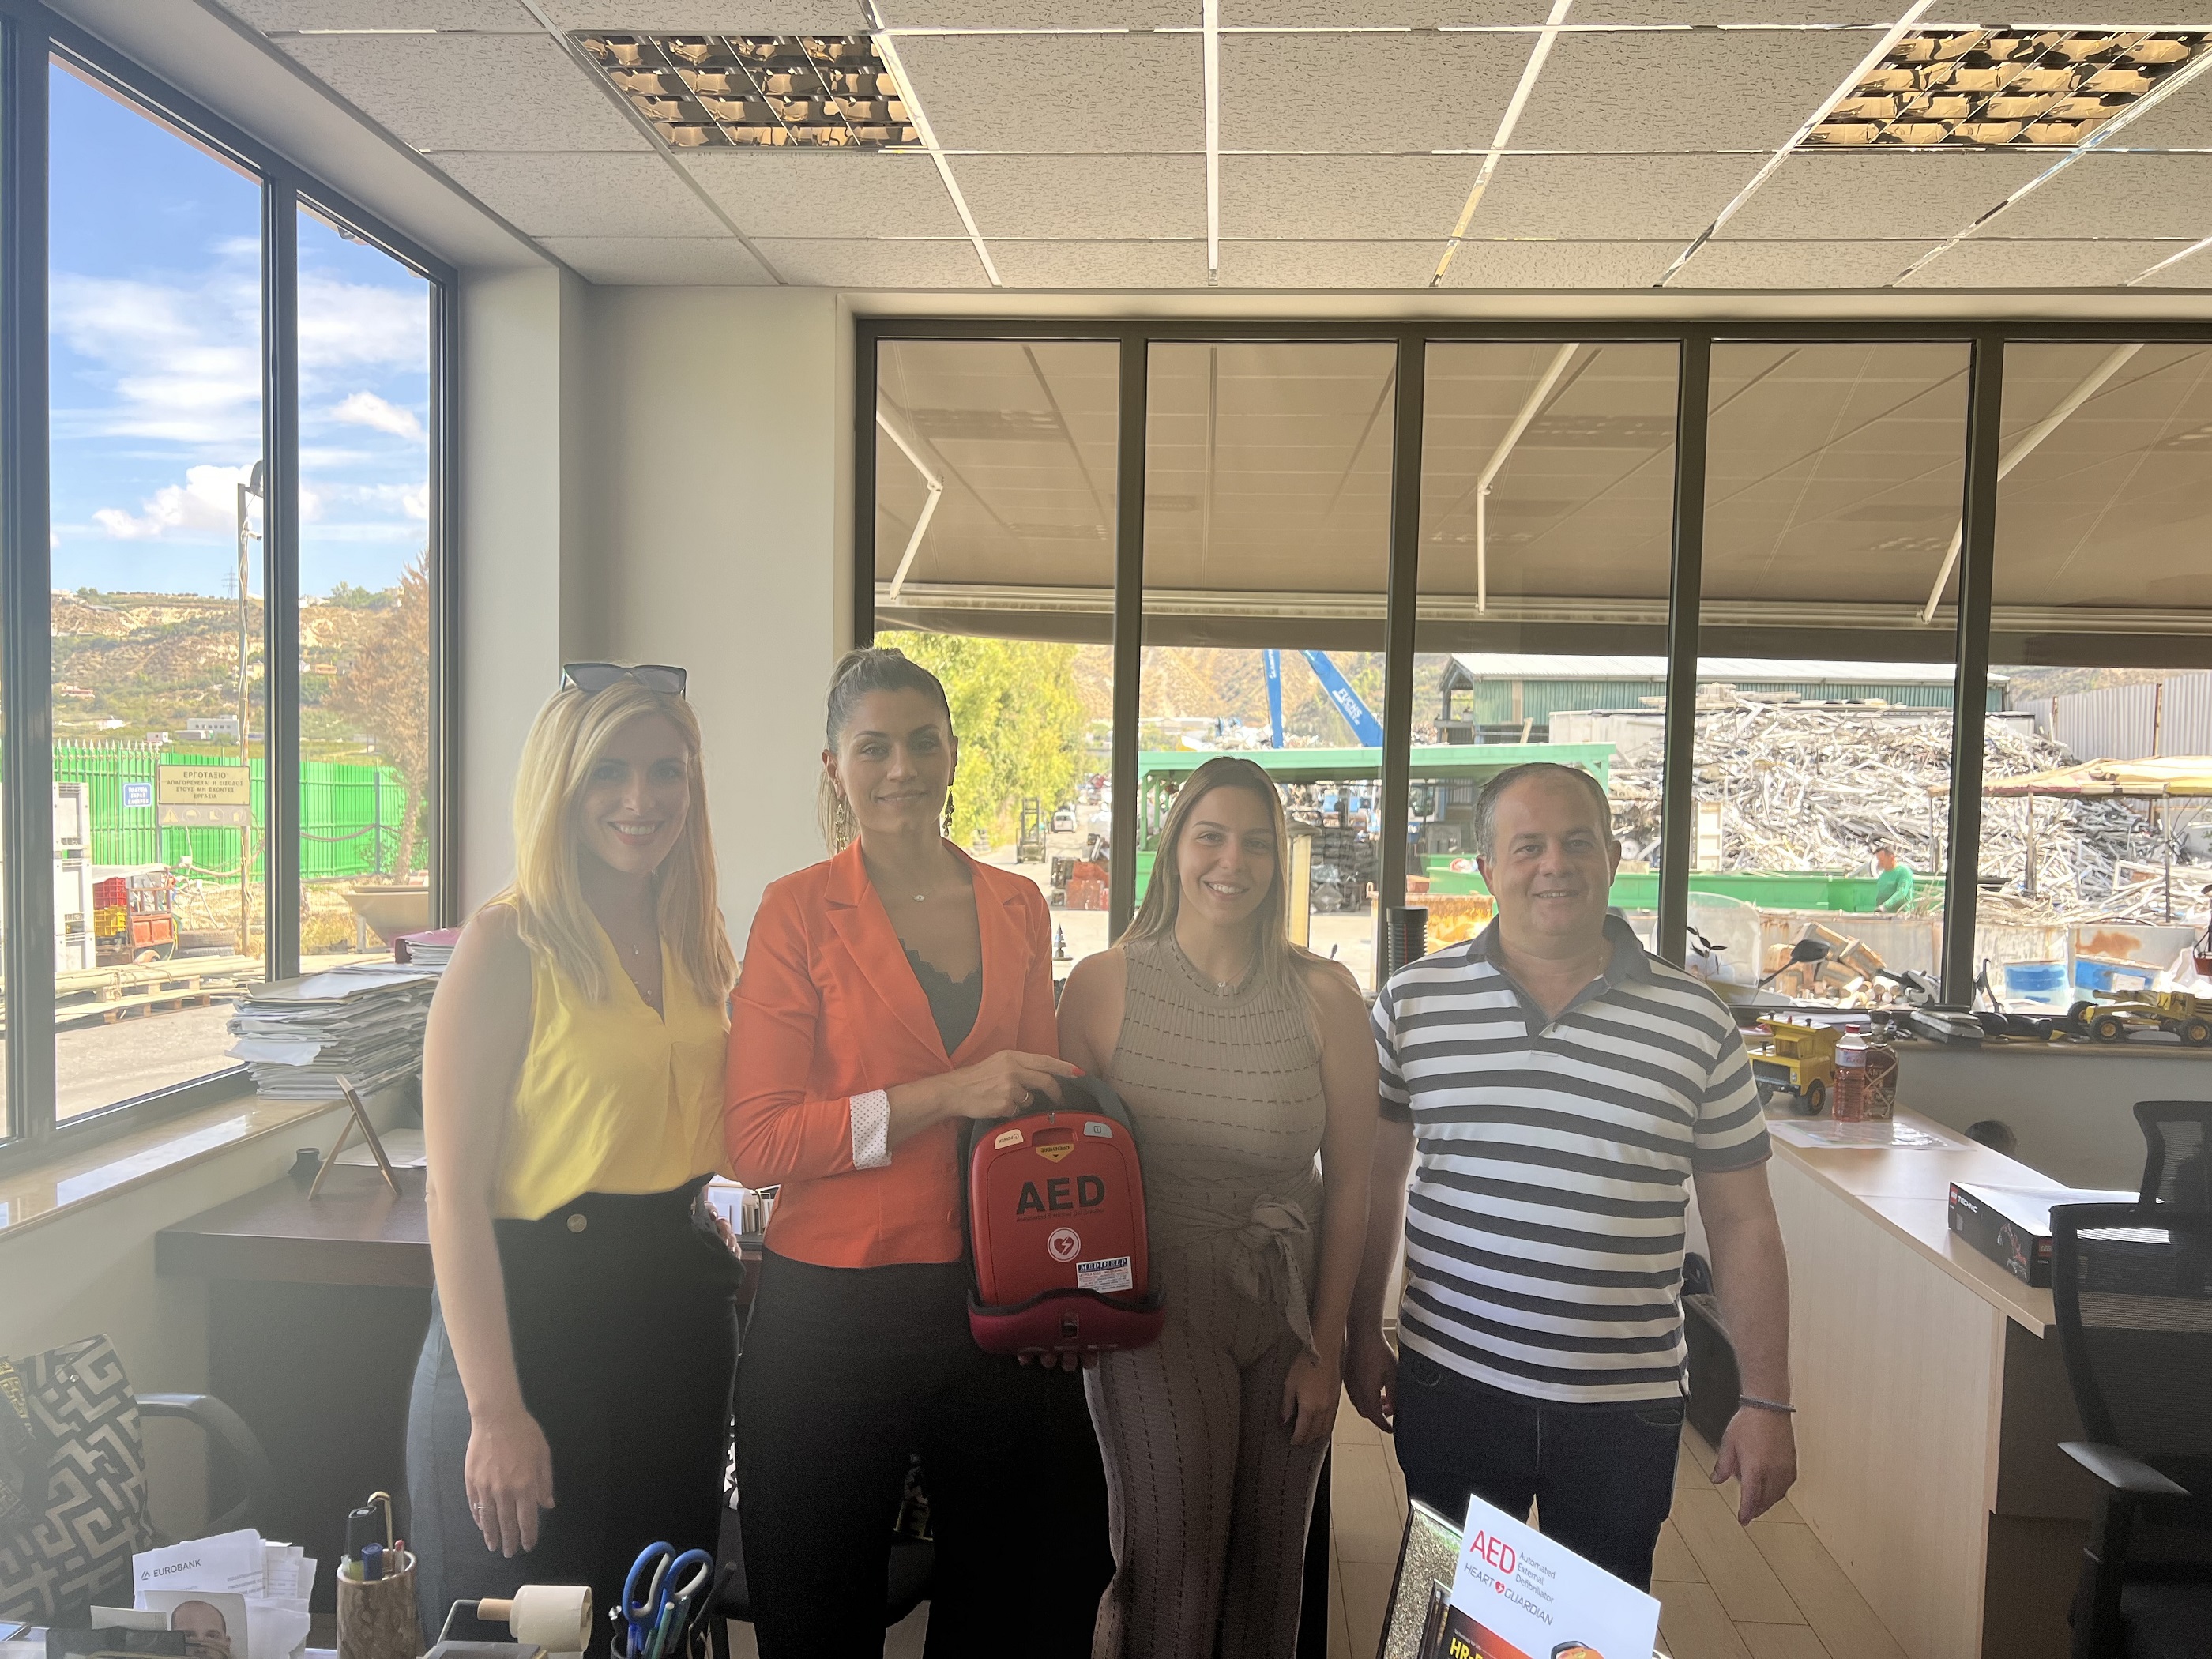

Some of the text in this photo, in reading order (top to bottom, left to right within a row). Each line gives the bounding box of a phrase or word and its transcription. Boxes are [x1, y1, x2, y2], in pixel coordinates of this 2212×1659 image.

[1338, 687, 1363, 715] FUCHS
[1016, 1175, 1105, 1215] AED
[1080, 1258, 1127, 1270] MEDIHELP
[1469, 1529, 1516, 1574] AED
[1519, 1552, 1556, 1579] Automated
[153, 1559, 202, 1578] EUROBANK
[1517, 1563, 1544, 1586] External
[1464, 1563, 1554, 1626] HEART GUARDIAN
[1515, 1574, 1555, 1604] Defibrillator
